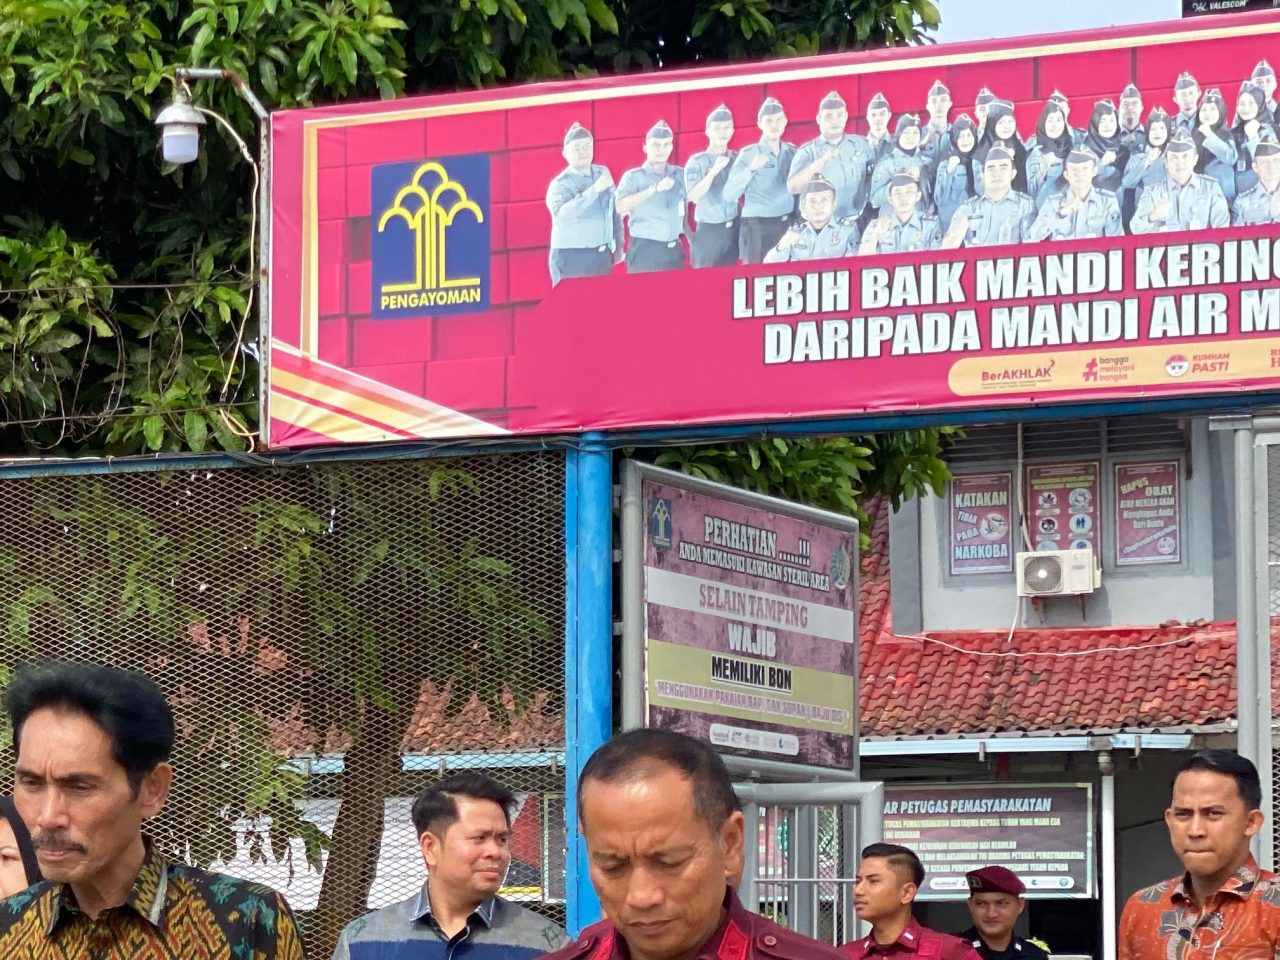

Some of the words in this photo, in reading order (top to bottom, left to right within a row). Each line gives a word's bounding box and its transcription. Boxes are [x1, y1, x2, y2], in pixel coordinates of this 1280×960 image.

[733, 270, 850, 318] LEBIH
[861, 261, 966, 309] BAIK
[976, 250, 1123, 301] MANDI
[381, 288, 481, 310] PENGAYOMAN
[763, 309, 982, 364] DARIPADA
[991, 298, 1138, 349] MANDI
[1148, 293, 1228, 339] AIR
[1100, 356, 1129, 366] bangga
[1192, 353, 1230, 362] KUMHAM
[982, 367, 1052, 381] BerAKHLAK
[1100, 363, 1135, 373] melayani
[1192, 361, 1229, 373] PASTI
[1145, 485, 1173, 496] OBAT
[955, 491, 1007, 507] KATAKAN
[958, 510, 978, 524] TIDAK
[703, 516, 777, 559] PERHATIAN
[956, 528, 979, 541] PADA
[955, 544, 1008, 559] NARKOBA
[679, 542, 702, 562] ANDA
[702, 546, 745, 574] MEMASUKI
[746, 557, 783, 582] KAWASAN
[783, 567, 810, 588] STERIL
[810, 573, 830, 592] AREA
[699, 584, 746, 616] SELAIN
[749, 593, 808, 628] TAMPING
[727, 623, 777, 658] WAJIB
[711, 656, 765, 685] MEMILIKI
[768, 666, 792, 691] BON
[900, 799, 949, 815] PETUGAS
[950, 798, 1052, 814] PEMASYARAKATAN
